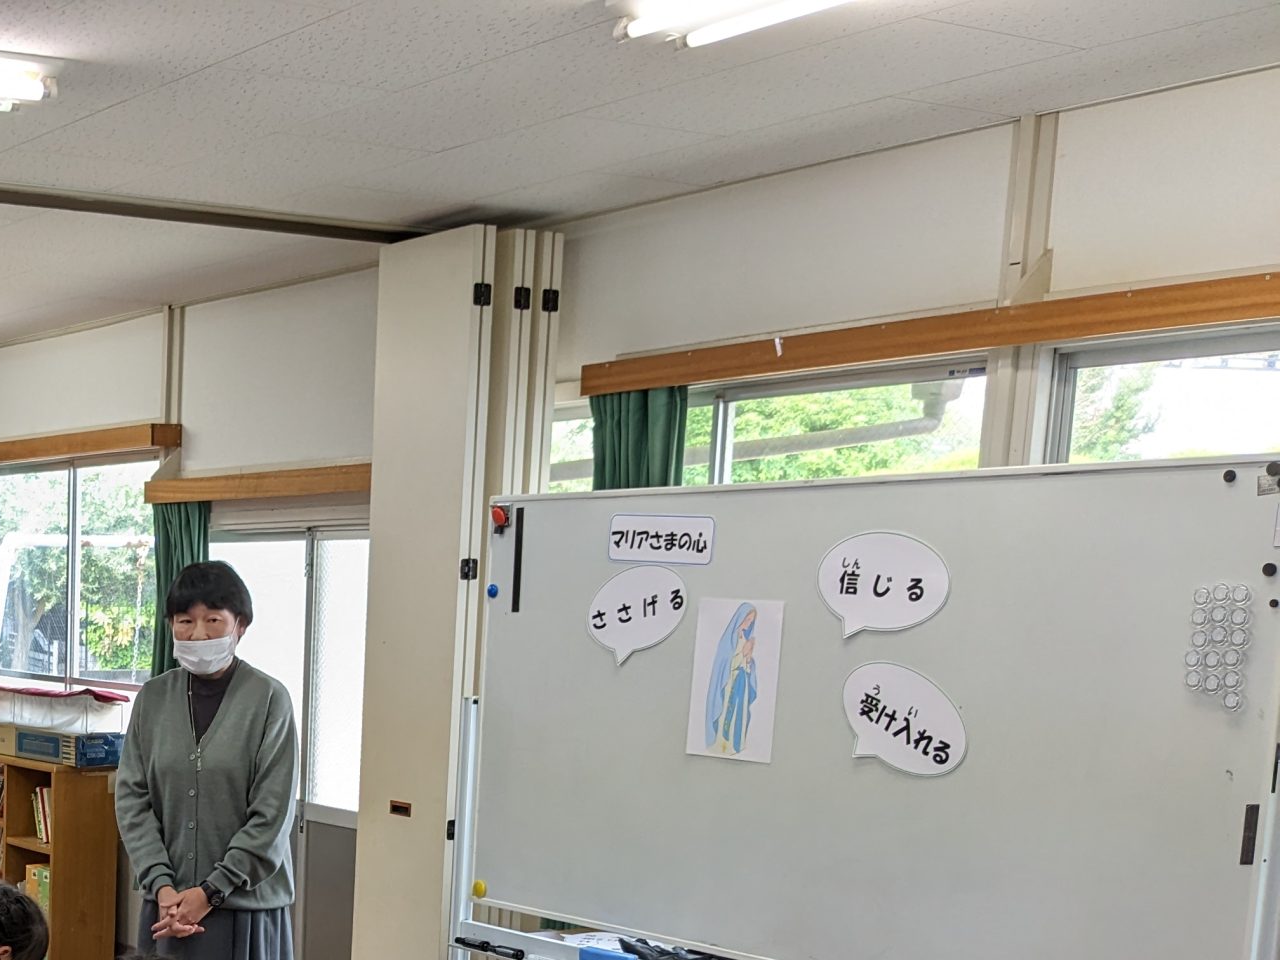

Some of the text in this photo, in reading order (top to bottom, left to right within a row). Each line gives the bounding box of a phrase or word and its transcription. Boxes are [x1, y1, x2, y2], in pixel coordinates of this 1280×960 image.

[611, 530, 708, 553] マリアさまの心
[841, 557, 861, 569] しん
[839, 570, 924, 602] 信じる
[592, 589, 684, 630] ささげる
[872, 684, 881, 696] う
[859, 692, 951, 765] 受け入れる
